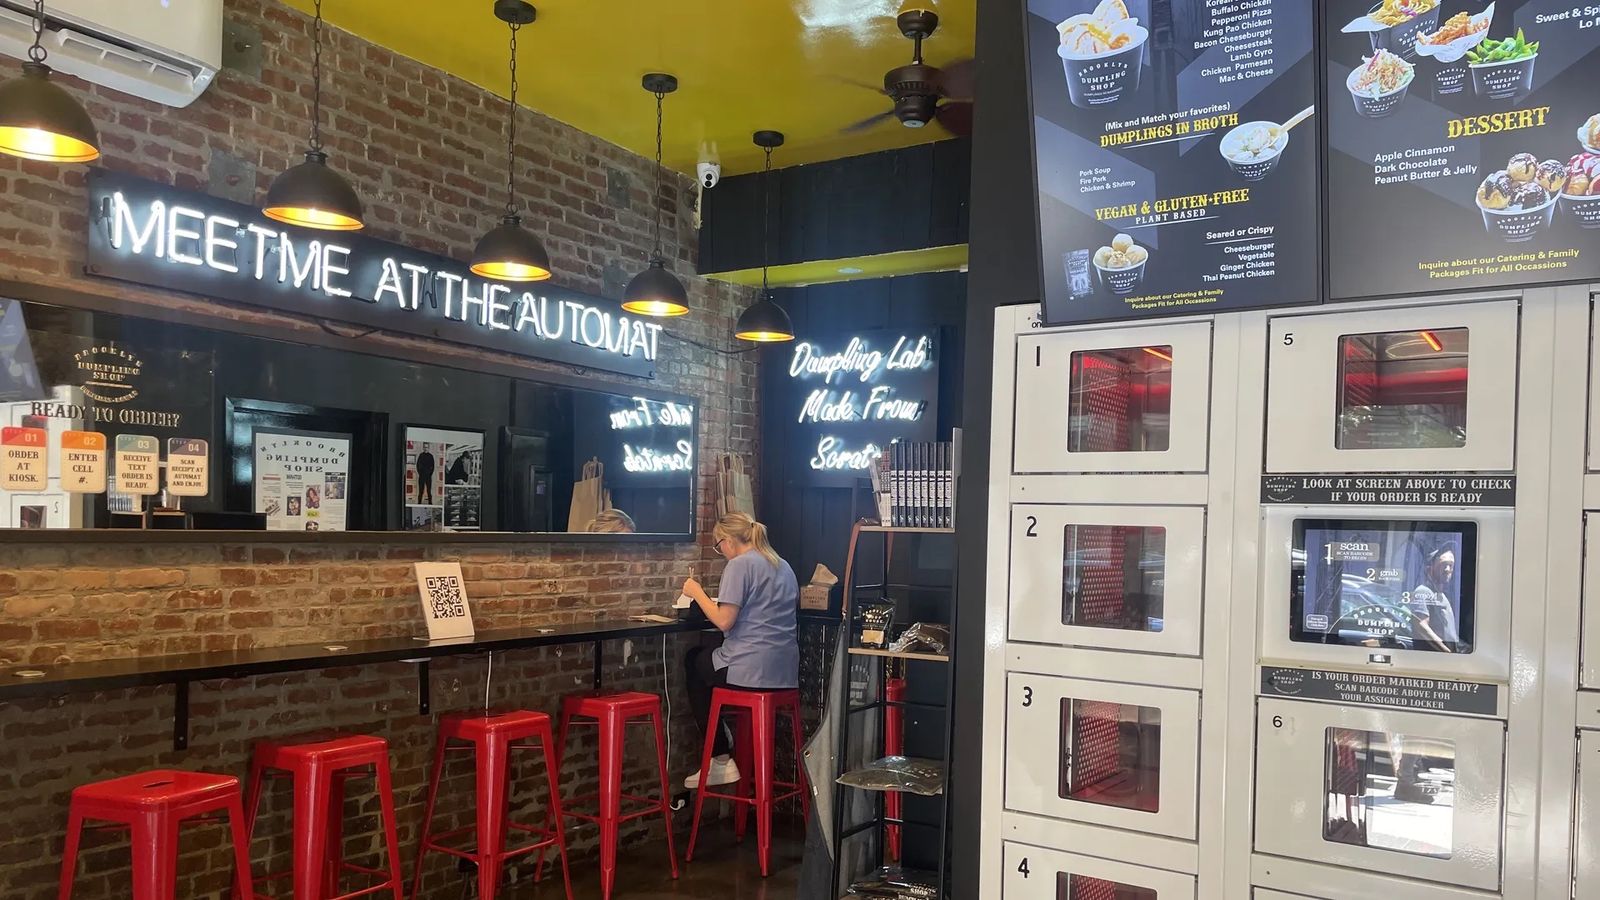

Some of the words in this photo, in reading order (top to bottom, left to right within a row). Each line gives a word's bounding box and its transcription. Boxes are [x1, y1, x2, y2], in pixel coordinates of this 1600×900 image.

[1211, 5, 1239, 16] Buffalo
[1240, 0, 1272, 10] Chicken
[1211, 12, 1250, 26] Pepperoni
[1252, 9, 1272, 18] Pizza
[1535, 10, 1570, 24] Sweet
[1572, 8, 1581, 18] &
[1203, 29, 1223, 38] Kung
[1225, 25, 1240, 33] Pao
[1241, 18, 1272, 29] Chicken
[1579, 20, 1593, 29] Lo
[1194, 39, 1218, 49] Bacon
[1219, 28, 1273, 44] Cheeseburger
[1224, 37, 1273, 53] Cheesesteak
[1230, 52, 1252, 62] Lamb
[1253, 48, 1273, 57] Gyro
[1201, 66, 1231, 77] Chicken
[1235, 58, 1273, 70] Parmesan
[1081, 70, 1126, 84] DUMPLING
[1219, 75, 1236, 83] Mac
[1245, 69, 1274, 79] Cheese
[1090, 81, 1115, 91] SHOP
[1105, 121, 1123, 131] (Mix
[1124, 117, 1140, 127] and
[1141, 113, 1167, 124] Match
[1169, 110, 1188, 121] your
[1190, 101, 1231, 117] favorites)
[1447, 106, 1550, 138] DESSERT
[1100, 124, 1173, 148] DUMPLINGS
[1175, 121, 1190, 135] IN
[1193, 112, 1239, 133] BROTH
[1375, 152, 1403, 163] Apple
[1404, 145, 1455, 158] Cinnamon
[1094, 167, 1111, 175] Soup
[1375, 164, 1397, 174] Dark
[1398, 158, 1448, 170] Chocolate
[1093, 175, 1106, 183] Pork
[1375, 173, 1408, 185] Peanut
[1410, 170, 1441, 180] Butter
[1443, 167, 1451, 176] &
[1453, 164, 1478, 175] Jelly
[1080, 184, 1104, 193] Chicken
[1112, 180, 1136, 189] Shrimp
[1095, 203, 1137, 221] VEGAN
[1141, 201, 1150, 214] &
[1135, 213, 1168, 224] PLANT
[1173, 209, 1206, 220] BASED
[1206, 229, 1235, 240] Seared
[1247, 226, 1275, 235] Crispy
[1224, 243, 1275, 253] Cheeseburger
[1238, 251, 1275, 261] Vegetable
[1418, 261, 1449, 271] Inquire
[1451, 259, 1477, 267] about
[1497, 252, 1536, 263] Catering
[1538, 251, 1546, 259] &
[1548, 248, 1579, 258] Family
[1220, 264, 1244, 272] Ginger
[1245, 261, 1275, 269] Chicken
[1430, 269, 1470, 278] Packages
[1472, 267, 1484, 275] Fit
[1486, 266, 1499, 274] for
[1500, 265, 1513, 273] All
[1514, 260, 1567, 271] Occassions
[113, 191, 278, 280] MEET
[279, 232, 352, 297] ME
[374, 257, 429, 310] AT
[437, 271, 511, 330] THE
[514, 292, 663, 362] AUTOMAT
[1203, 274, 1218, 282] Thai
[1219, 272, 1244, 280] Peanut
[1246, 269, 1275, 278] Chicken
[1283, 333, 1294, 346] 5
[790, 337, 881, 384] Dumpling
[887, 336, 927, 370] Lab
[78, 362, 140, 375] DUMPLING
[93, 371, 126, 381] SHOP
[798, 389, 852, 423] Made
[862, 386, 919, 421] From
[30, 402, 86, 420] READY
[92, 406, 113, 422] TO
[119, 408, 181, 427] ORDER?
[25, 433, 37, 442] 01
[83, 437, 96, 446] 02
[138, 440, 150, 449] 03
[8, 450, 39, 459] ORDER
[188, 444, 200, 452] 04
[69, 453, 98, 461] ENTER
[72, 465, 94, 473] CELL
[9, 474, 39, 483] KIOSK.
[1302, 477, 1332, 489] LOOK
[1336, 477, 1352, 489] AT
[1355, 478, 1401, 489] SCREEN
[1405, 478, 1445, 490] ABOVE
[1451, 478, 1467, 490] TO
[1470, 479, 1512, 490] CHECK
[1330, 492, 1343, 502] IF
[1346, 492, 1376, 502] YOUR
[1380, 492, 1421, 503] ORDER
[1424, 492, 1437, 503] IS
[1441, 493, 1483, 503] READY
[1027, 515, 1038, 537] 2
[1324, 543, 1334, 562] 1
[1340, 543, 1369, 551] scan
[1366, 568, 1376, 581] 2
[1401, 591, 1410, 604] 3
[1367, 628, 1394, 636] SHOP
[1312, 671, 1322, 680] IS
[1325, 671, 1350, 682] YOUR
[1352, 673, 1386, 684] ORDER
[1389, 676, 1434, 689] MARKED
[1437, 680, 1479, 694] READY?
[1022, 686, 1033, 707] 3
[1334, 682, 1357, 692] SCAN
[1359, 684, 1399, 696] BARCODE
[1401, 687, 1431, 699] ABOVE
[1433, 690, 1451, 700] FOR
[1340, 692, 1362, 702] YOUR
[1364, 694, 1408, 706] ASSIGNED
[1410, 698, 1445, 710] LOCKER
[1272, 715, 1283, 728] 6
[1017, 857, 1030, 879] 4
